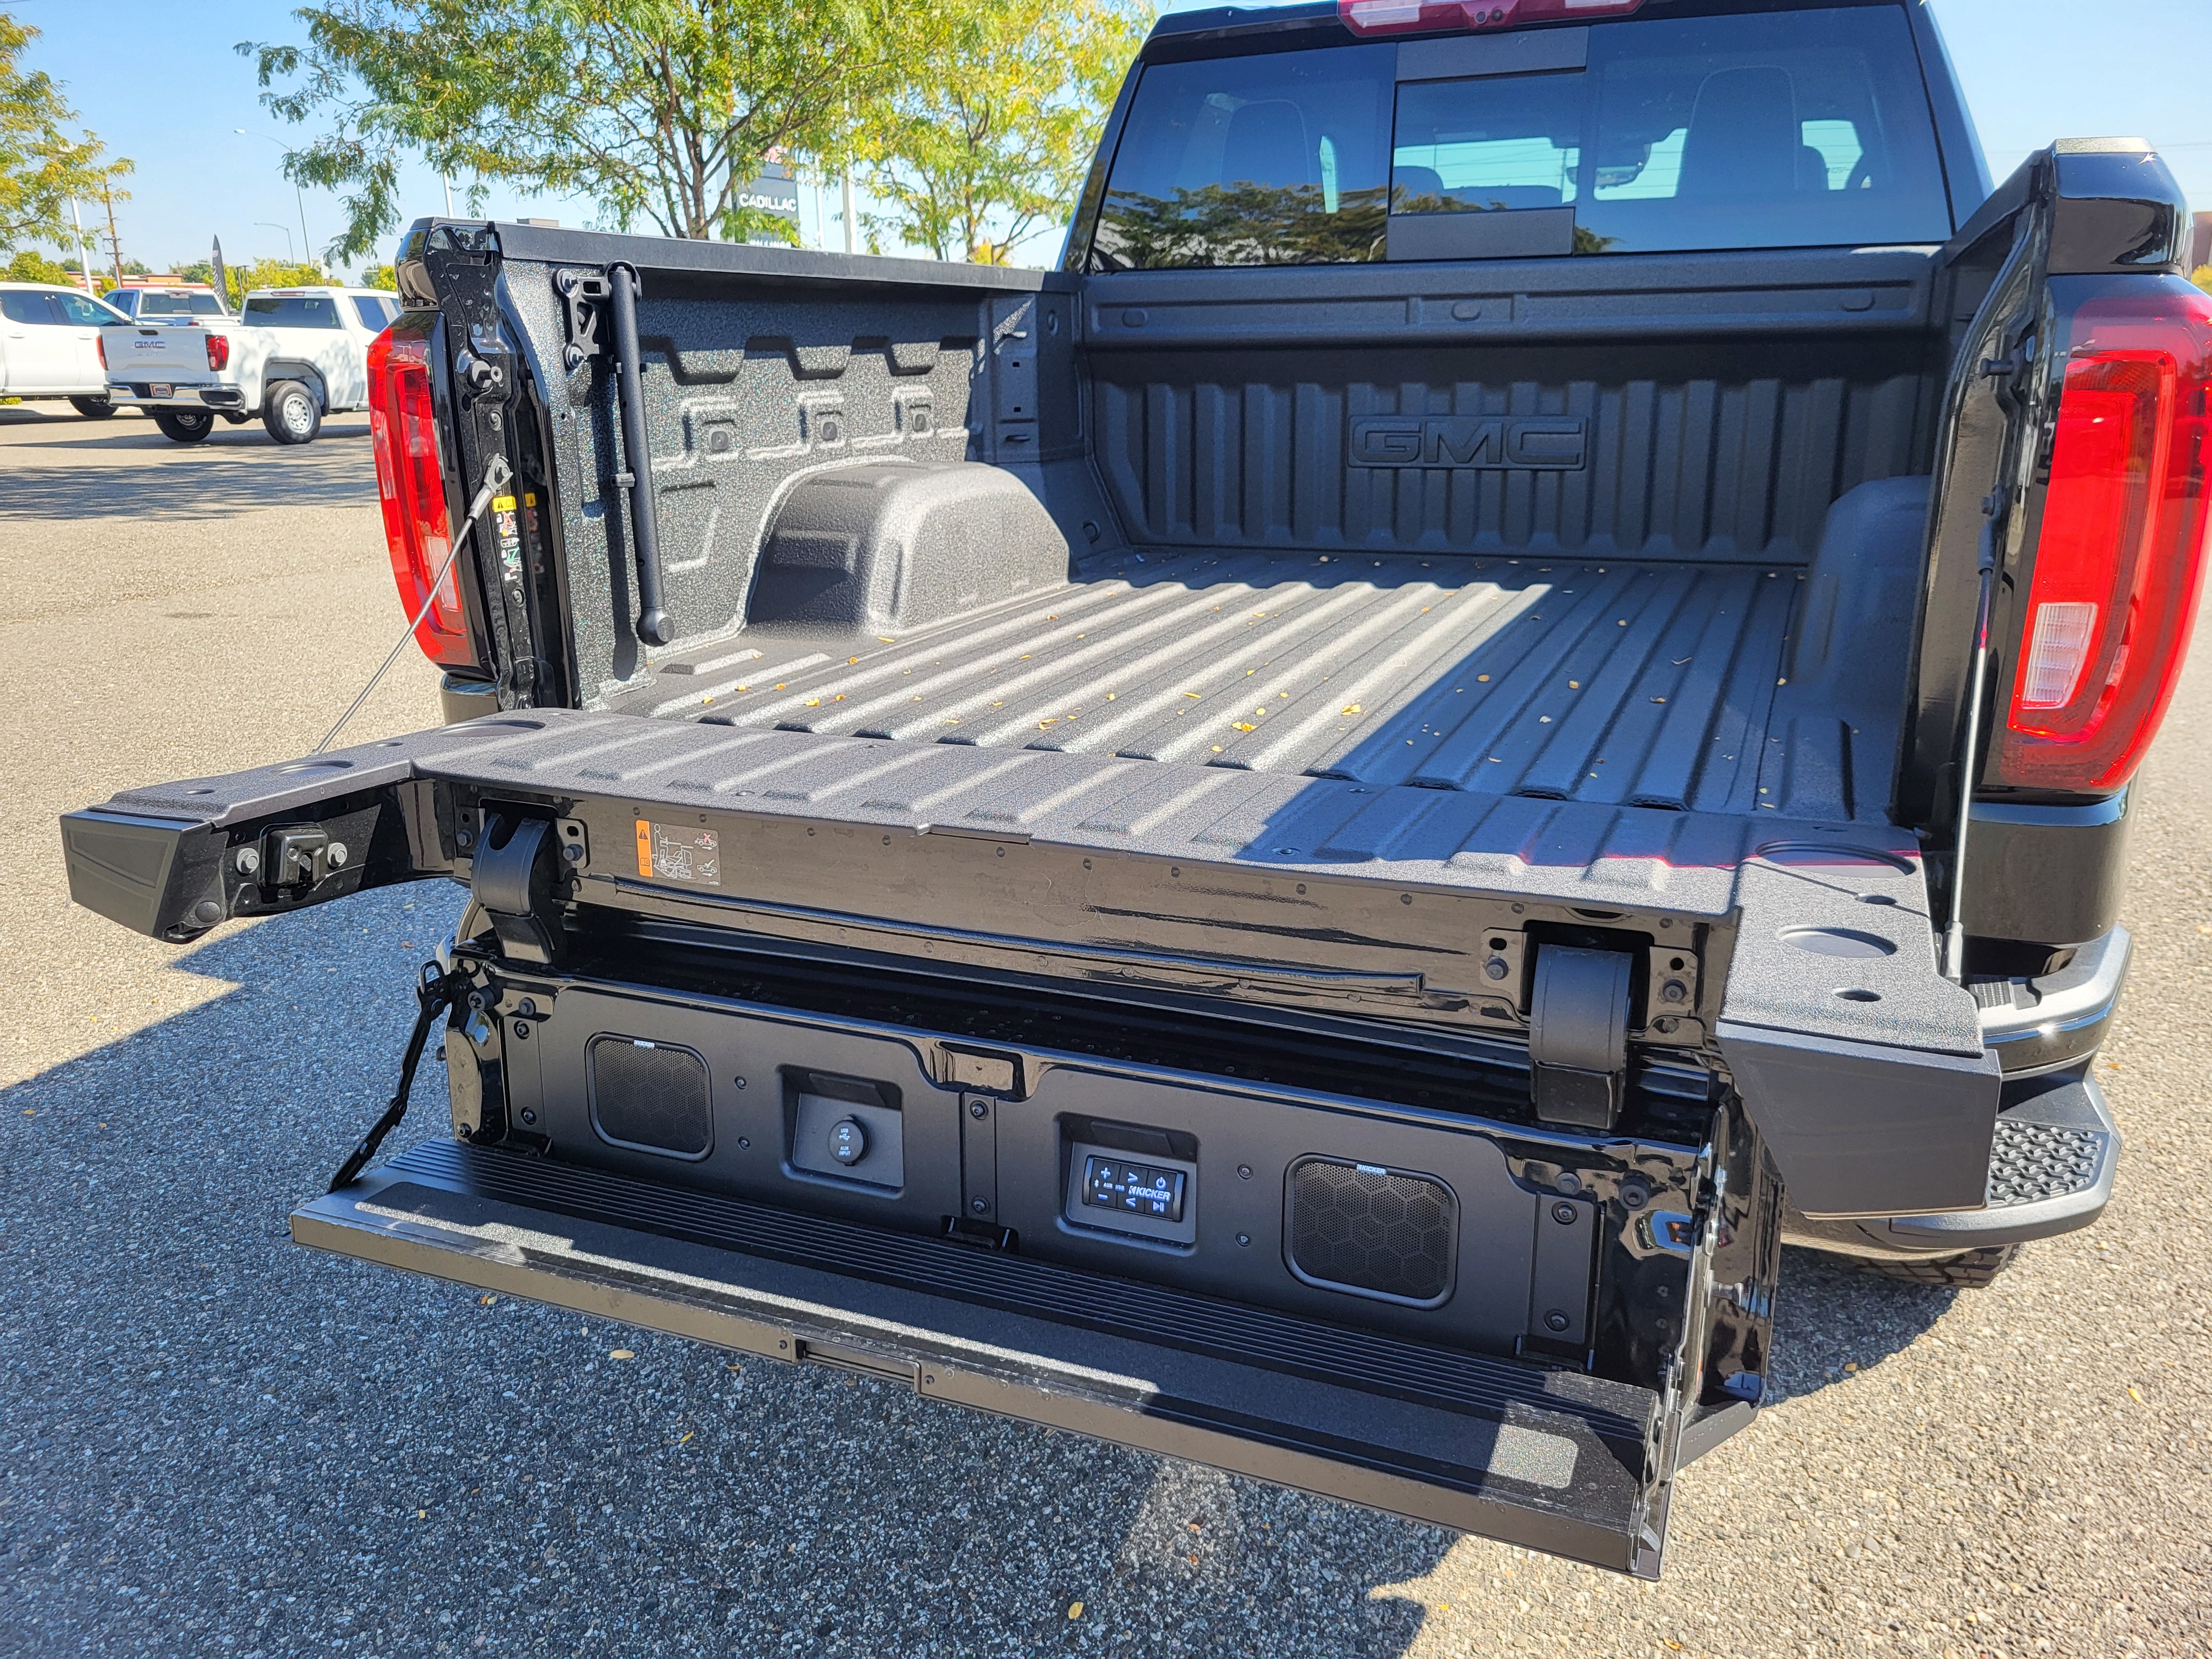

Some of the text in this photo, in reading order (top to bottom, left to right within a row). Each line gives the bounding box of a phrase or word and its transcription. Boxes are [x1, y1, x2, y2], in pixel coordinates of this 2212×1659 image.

[739, 192, 796, 212] CADILLAC
[1353, 421, 1582, 465] GMC
[1361, 1165, 1386, 1175] KICKER
[1115, 1184, 1125, 1192] USB
[1136, 1187, 1171, 1202] KICKER
